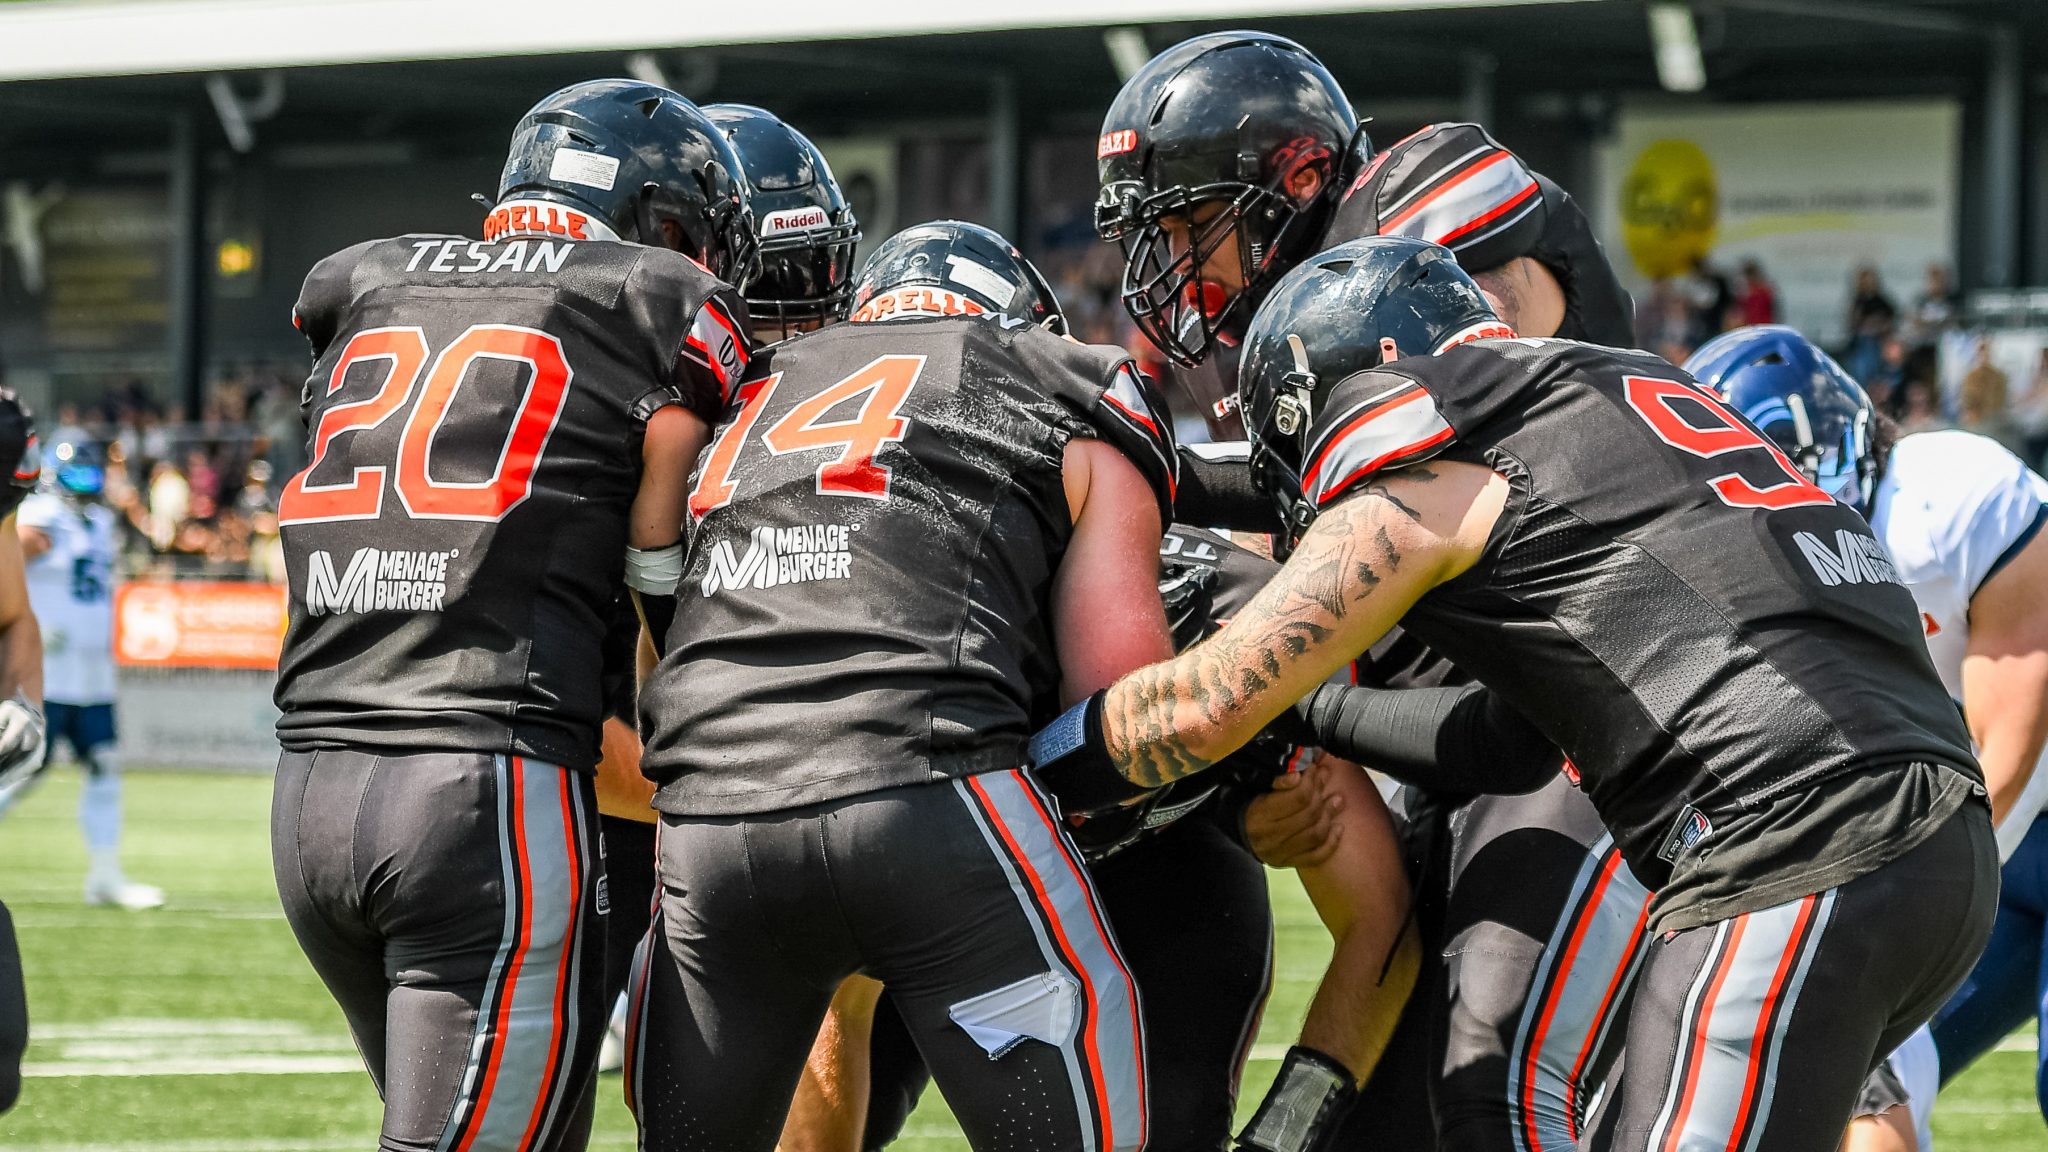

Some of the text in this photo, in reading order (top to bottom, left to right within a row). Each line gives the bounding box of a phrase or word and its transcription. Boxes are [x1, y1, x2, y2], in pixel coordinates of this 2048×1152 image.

[773, 211, 823, 230] Riddell
[405, 240, 575, 273] TESAN
[278, 323, 575, 526] 20
[687, 354, 928, 527] 14
[1622, 375, 1837, 511] 9
[778, 551, 853, 586] BURGER
[375, 580, 446, 613] BURGER
